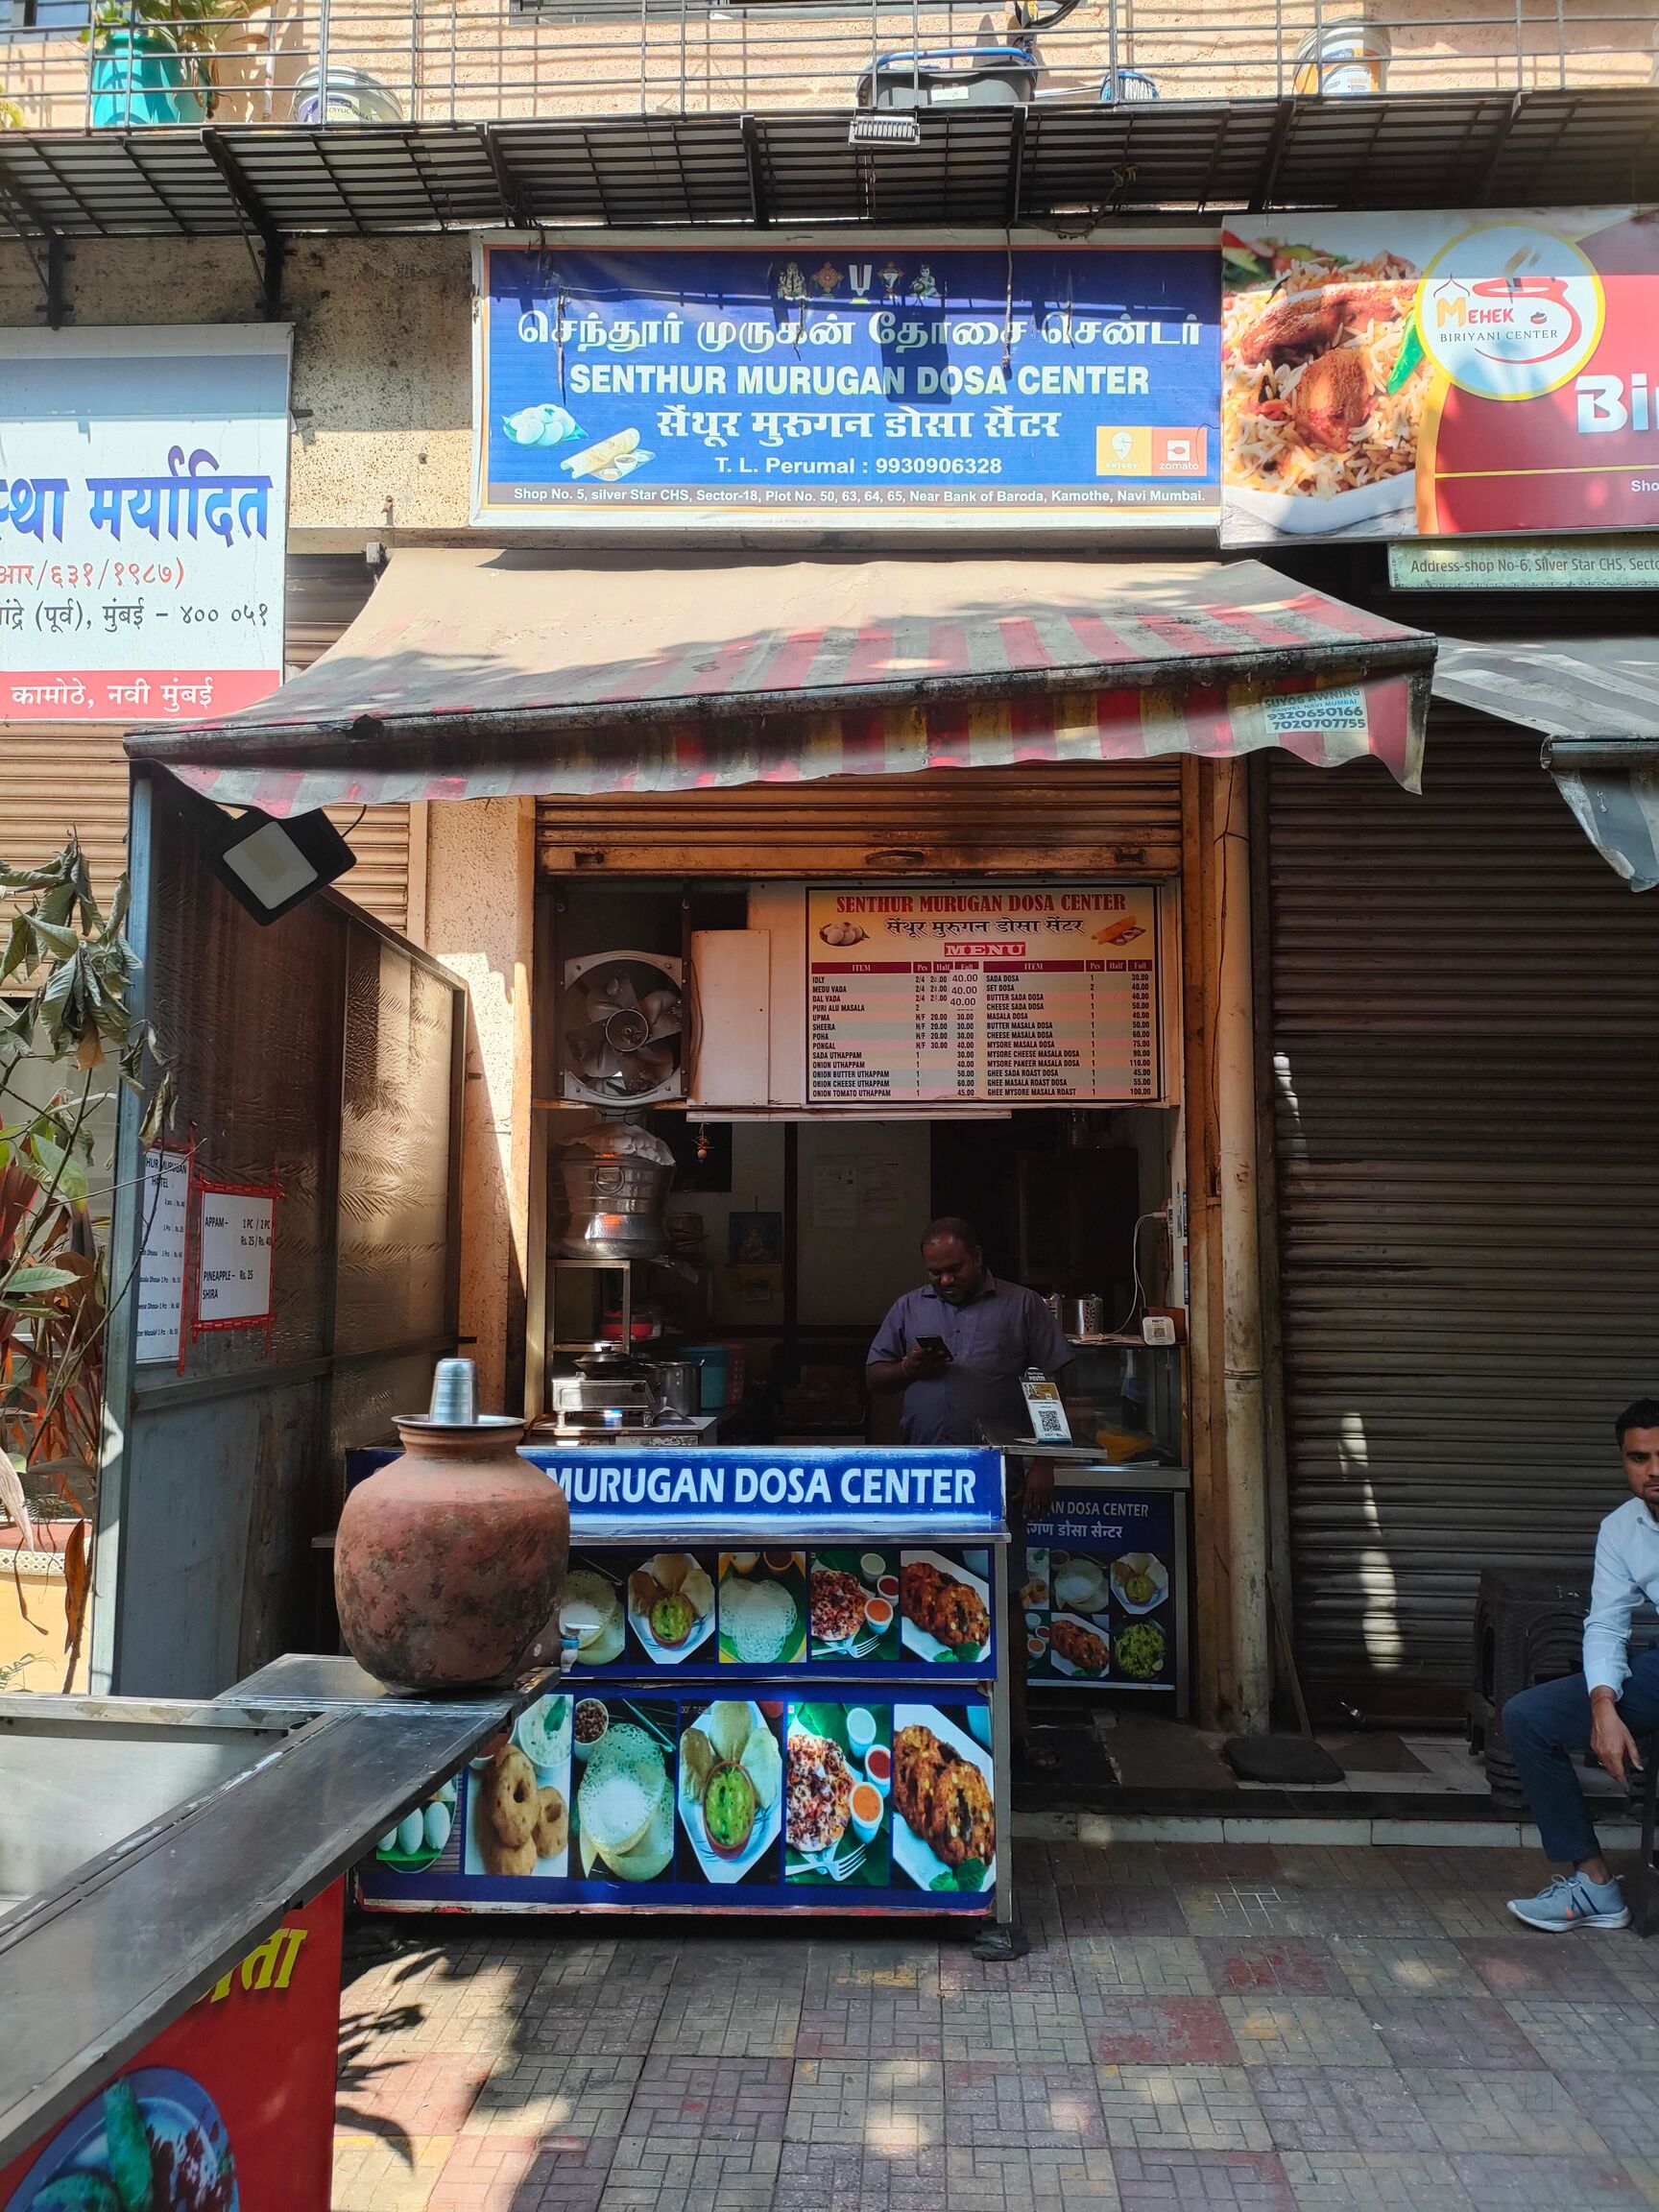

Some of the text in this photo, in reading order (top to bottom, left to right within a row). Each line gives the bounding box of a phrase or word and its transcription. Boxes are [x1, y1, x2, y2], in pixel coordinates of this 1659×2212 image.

[1436, 297, 1514, 328] MEHEK
[698, 313, 856, 353] முருகன்
[869, 311, 1026, 353] தோசை
[1043, 311, 1203, 346] சென்டர்
[1440, 329, 1558, 343] BIRIYANI CENTER
[569, 364, 1150, 396] SENTHUR MURUGAN DOSA CENTER
[751, 411, 876, 447] मुरुगन
[884, 406, 974, 438] डोसा
[714, 457, 732, 473] T.
[740, 458, 757, 473] L.
[766, 457, 855, 474] Perumal
[876, 458, 1002, 474] 9930906328
[1159, 461, 1200, 470] zomato
[84, 445, 274, 547] मर्यादित
[514, 488, 1206, 504] Shop No. 5, silver Star CHS, Sector-18, Plot No. 50, 63, 64, 65, Near Bank of Baroda, Kamothe, Navi Mumbai.
[1411, 559, 1494, 574] Address-shop
[1498, 559, 1532, 573] No-6,
[1534, 557, 1568, 572] Silver
[1572, 558, 1596, 571] Star
[1599, 558, 1626, 572] CHS,
[102, 597, 145, 633] मुंबई
[181, 605, 219, 623] ४००
[231, 604, 269, 626] ०५१
[11, 677, 214, 712] कामोठे, नवी मुंबई
[1263, 687, 1360, 709] SUYOG AWNING
[1266, 707, 1363, 721] 9320650166
[1272, 718, 1366, 730] 7020707755
[836, 893, 1127, 913] SENTHUR MURUGAN DOSA CENTER
[931, 919, 990, 938] मुरुगन
[996, 916, 1041, 934] डोसा
[1046, 916, 1085, 934] सेंटर
[946, 944, 1025, 956] MENU
[952, 974, 977, 982] 40.00
[951, 986, 977, 995] 40.00
[950, 998, 976, 1006] 40.00
[546, 1467, 976, 1504] MURUGAN DOSA CENTER
[1067, 1501, 1101, 1515] DOSA
[1102, 1502, 1149, 1517] CENTER
[1057, 1520, 1088, 1537] डोसा
